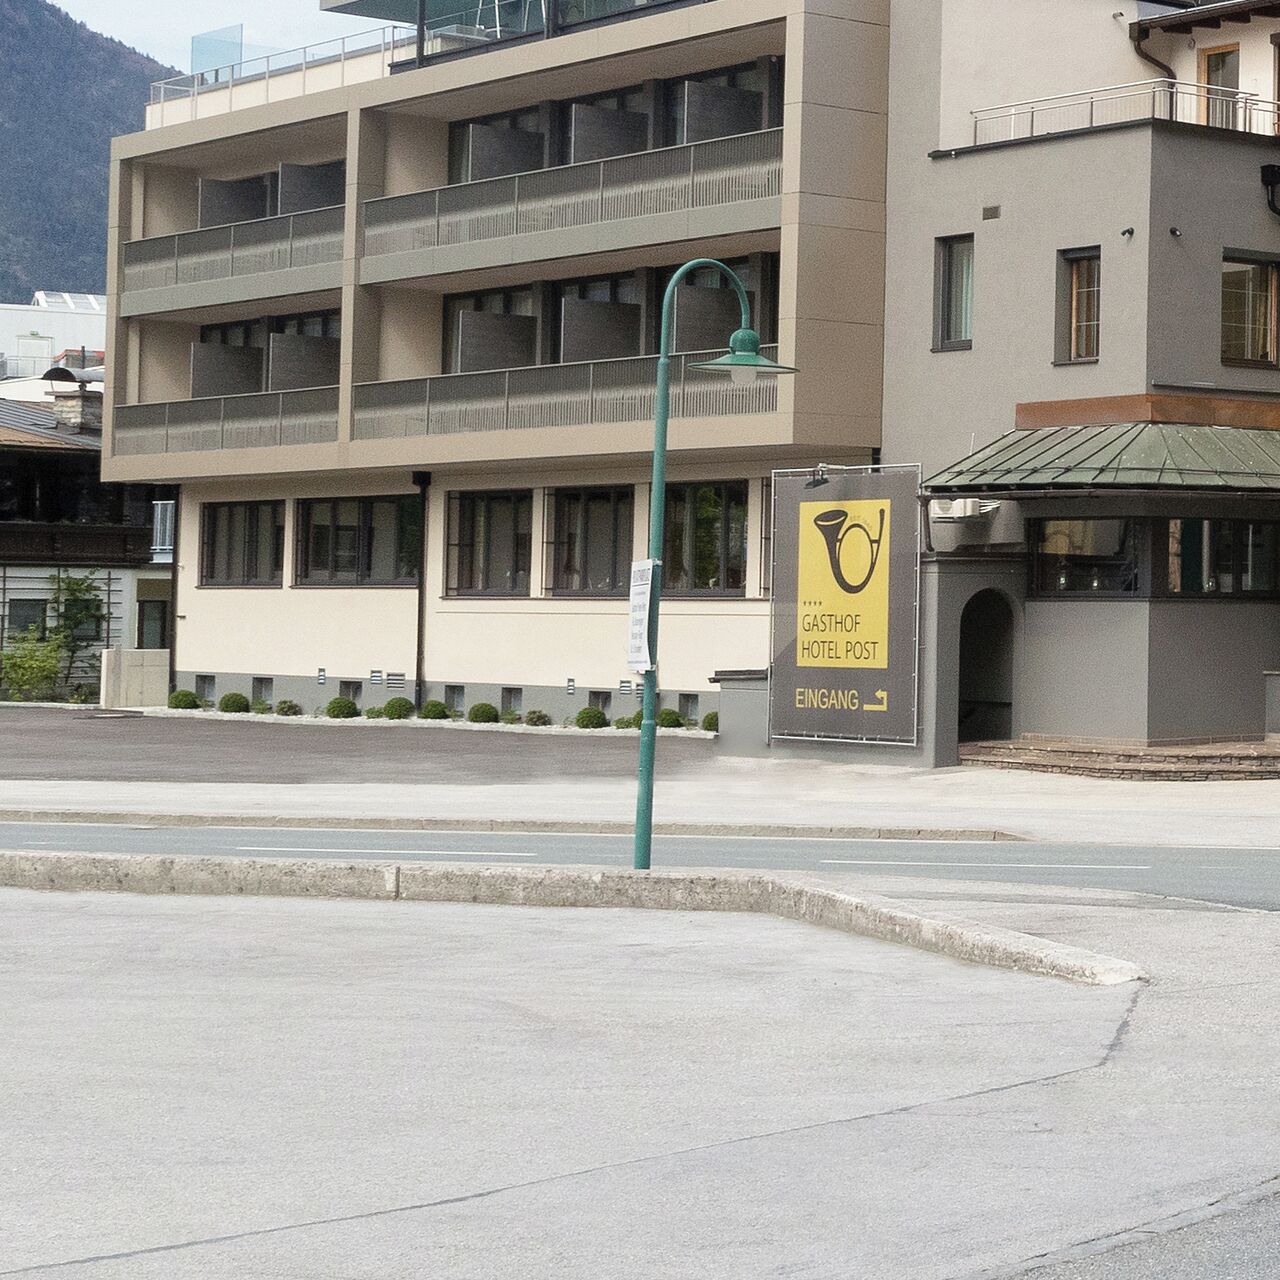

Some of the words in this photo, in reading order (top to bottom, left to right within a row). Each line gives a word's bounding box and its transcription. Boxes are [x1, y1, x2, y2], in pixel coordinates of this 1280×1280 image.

[802, 614, 861, 632] GASTHOF
[801, 640, 841, 659] HOTEL
[845, 641, 879, 660] POST
[795, 688, 859, 710] EINGANG
